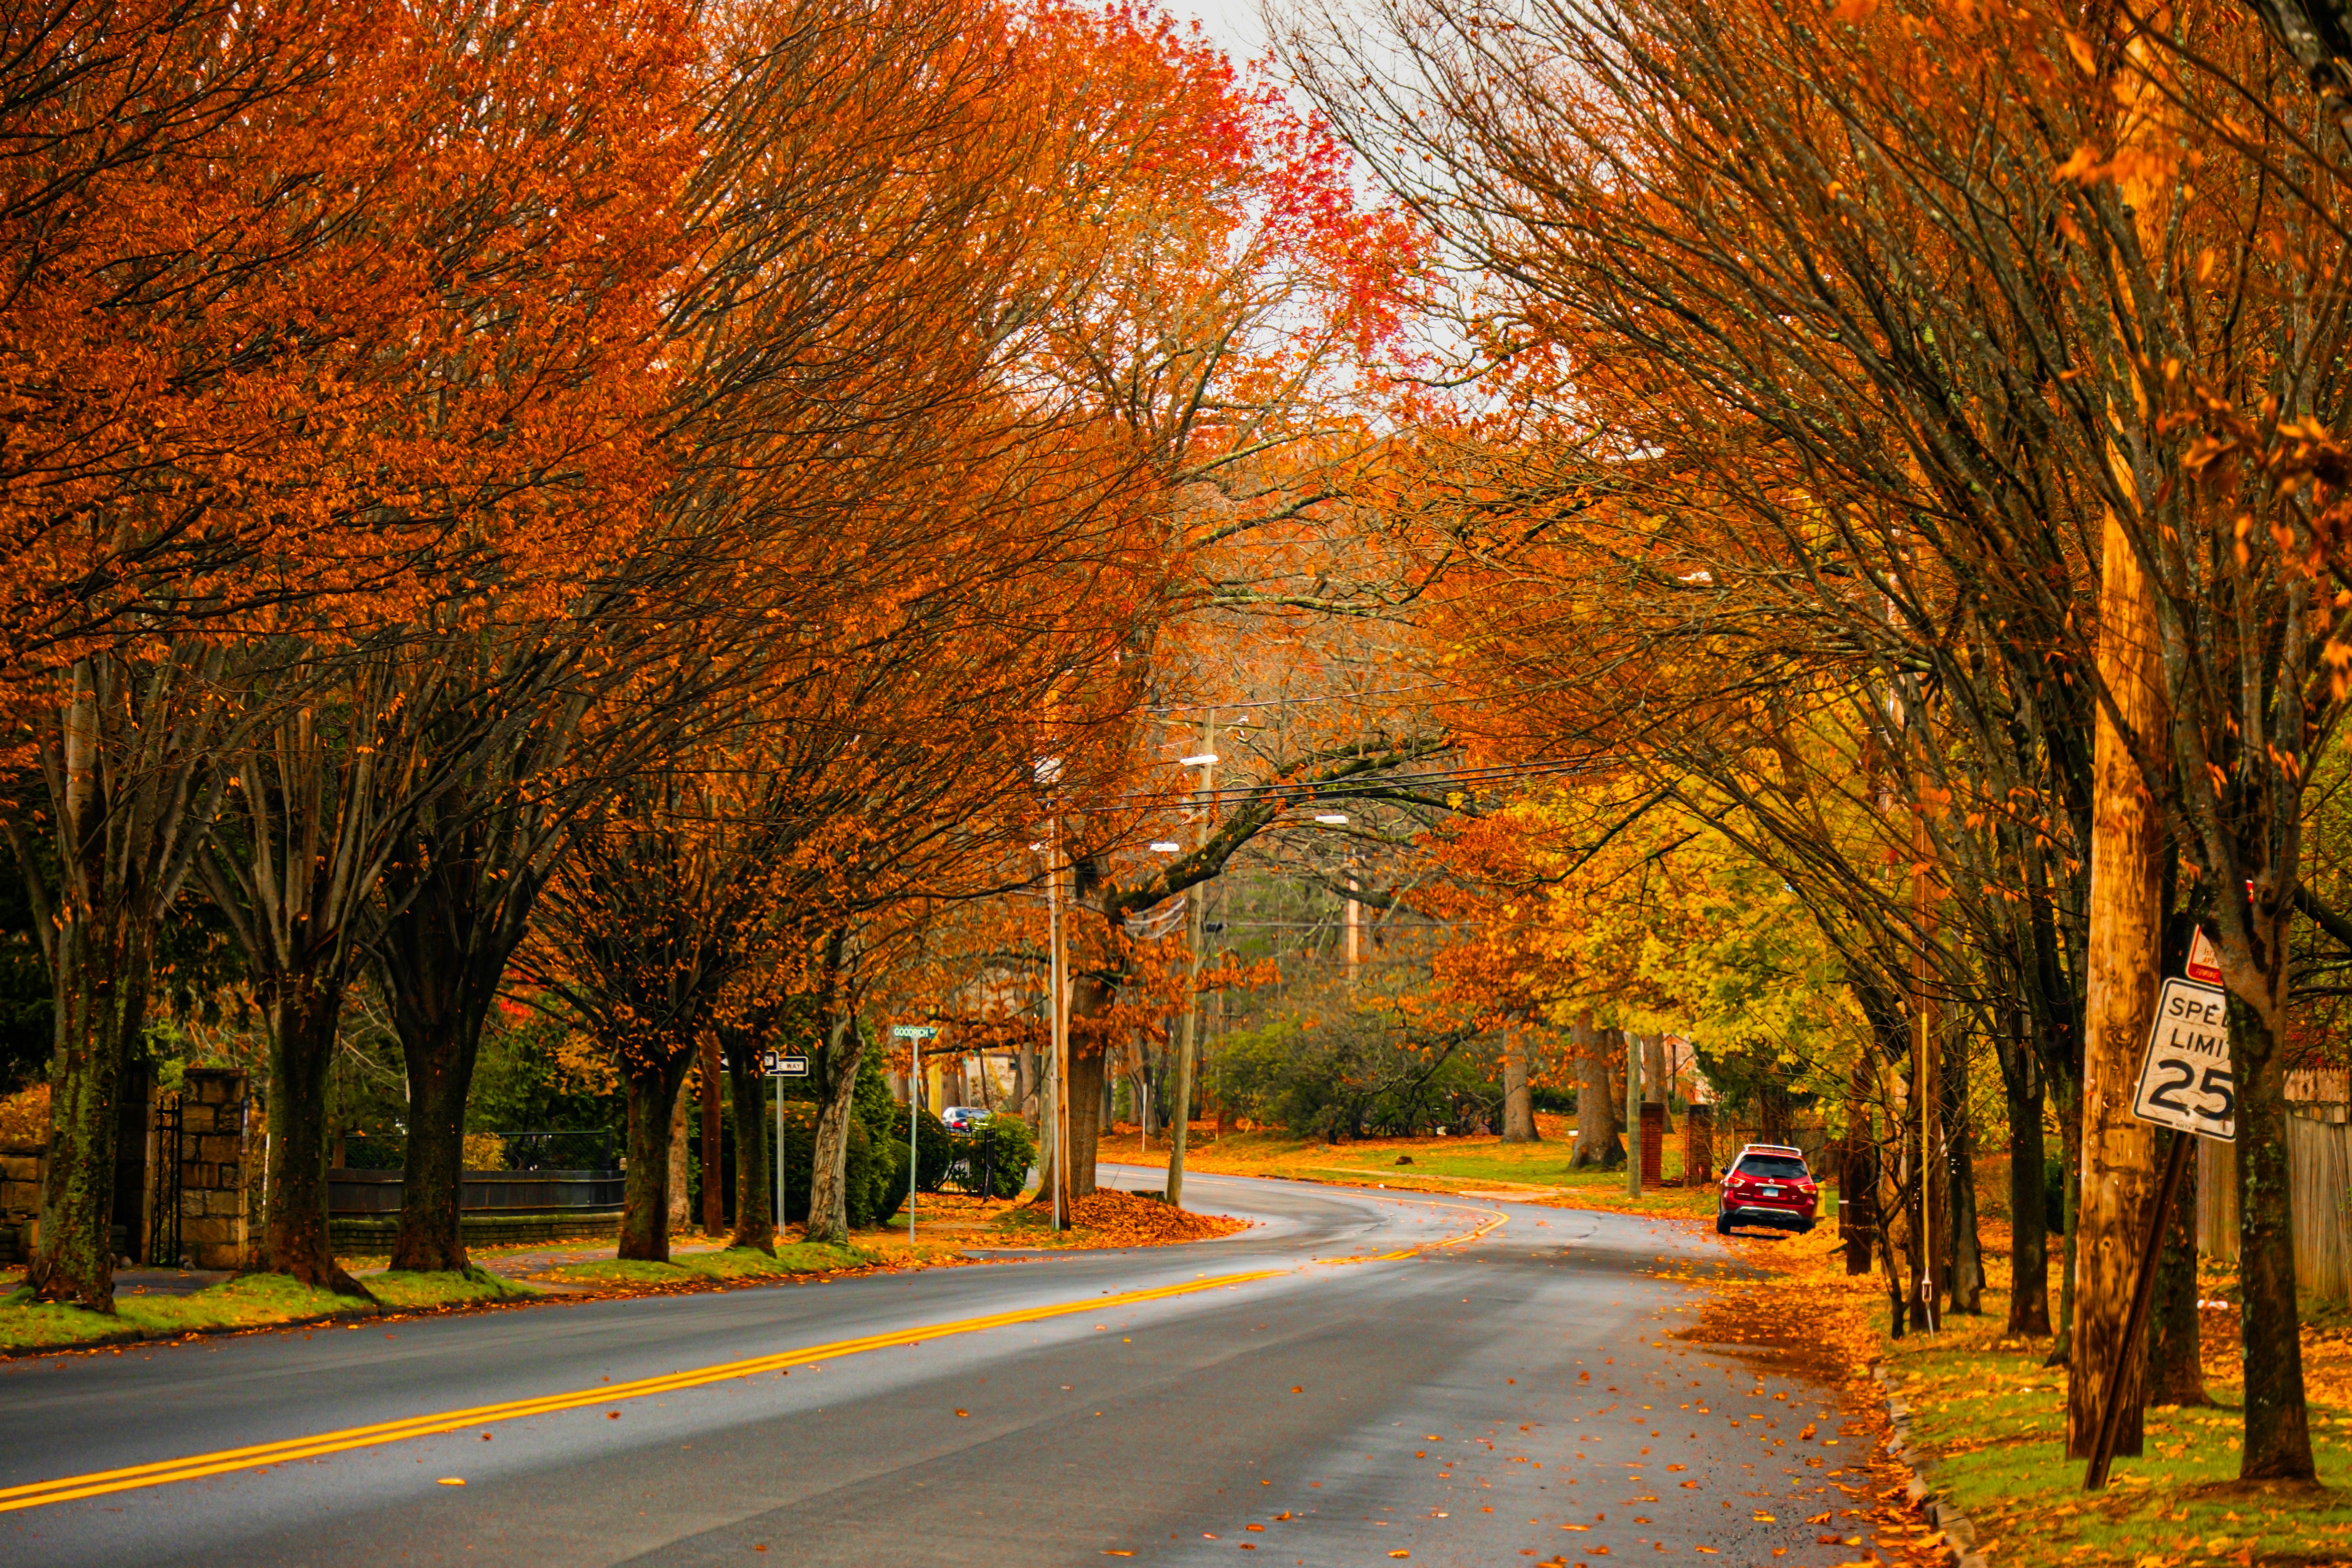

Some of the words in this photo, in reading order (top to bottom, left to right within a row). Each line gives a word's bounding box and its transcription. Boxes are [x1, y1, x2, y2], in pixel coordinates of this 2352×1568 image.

[2196, 968, 2218, 978] TOWING
[895, 1027, 928, 1037] GOODRICH
[2170, 1028, 2229, 1058] LIMI
[2148, 1059, 2234, 1121] 25
